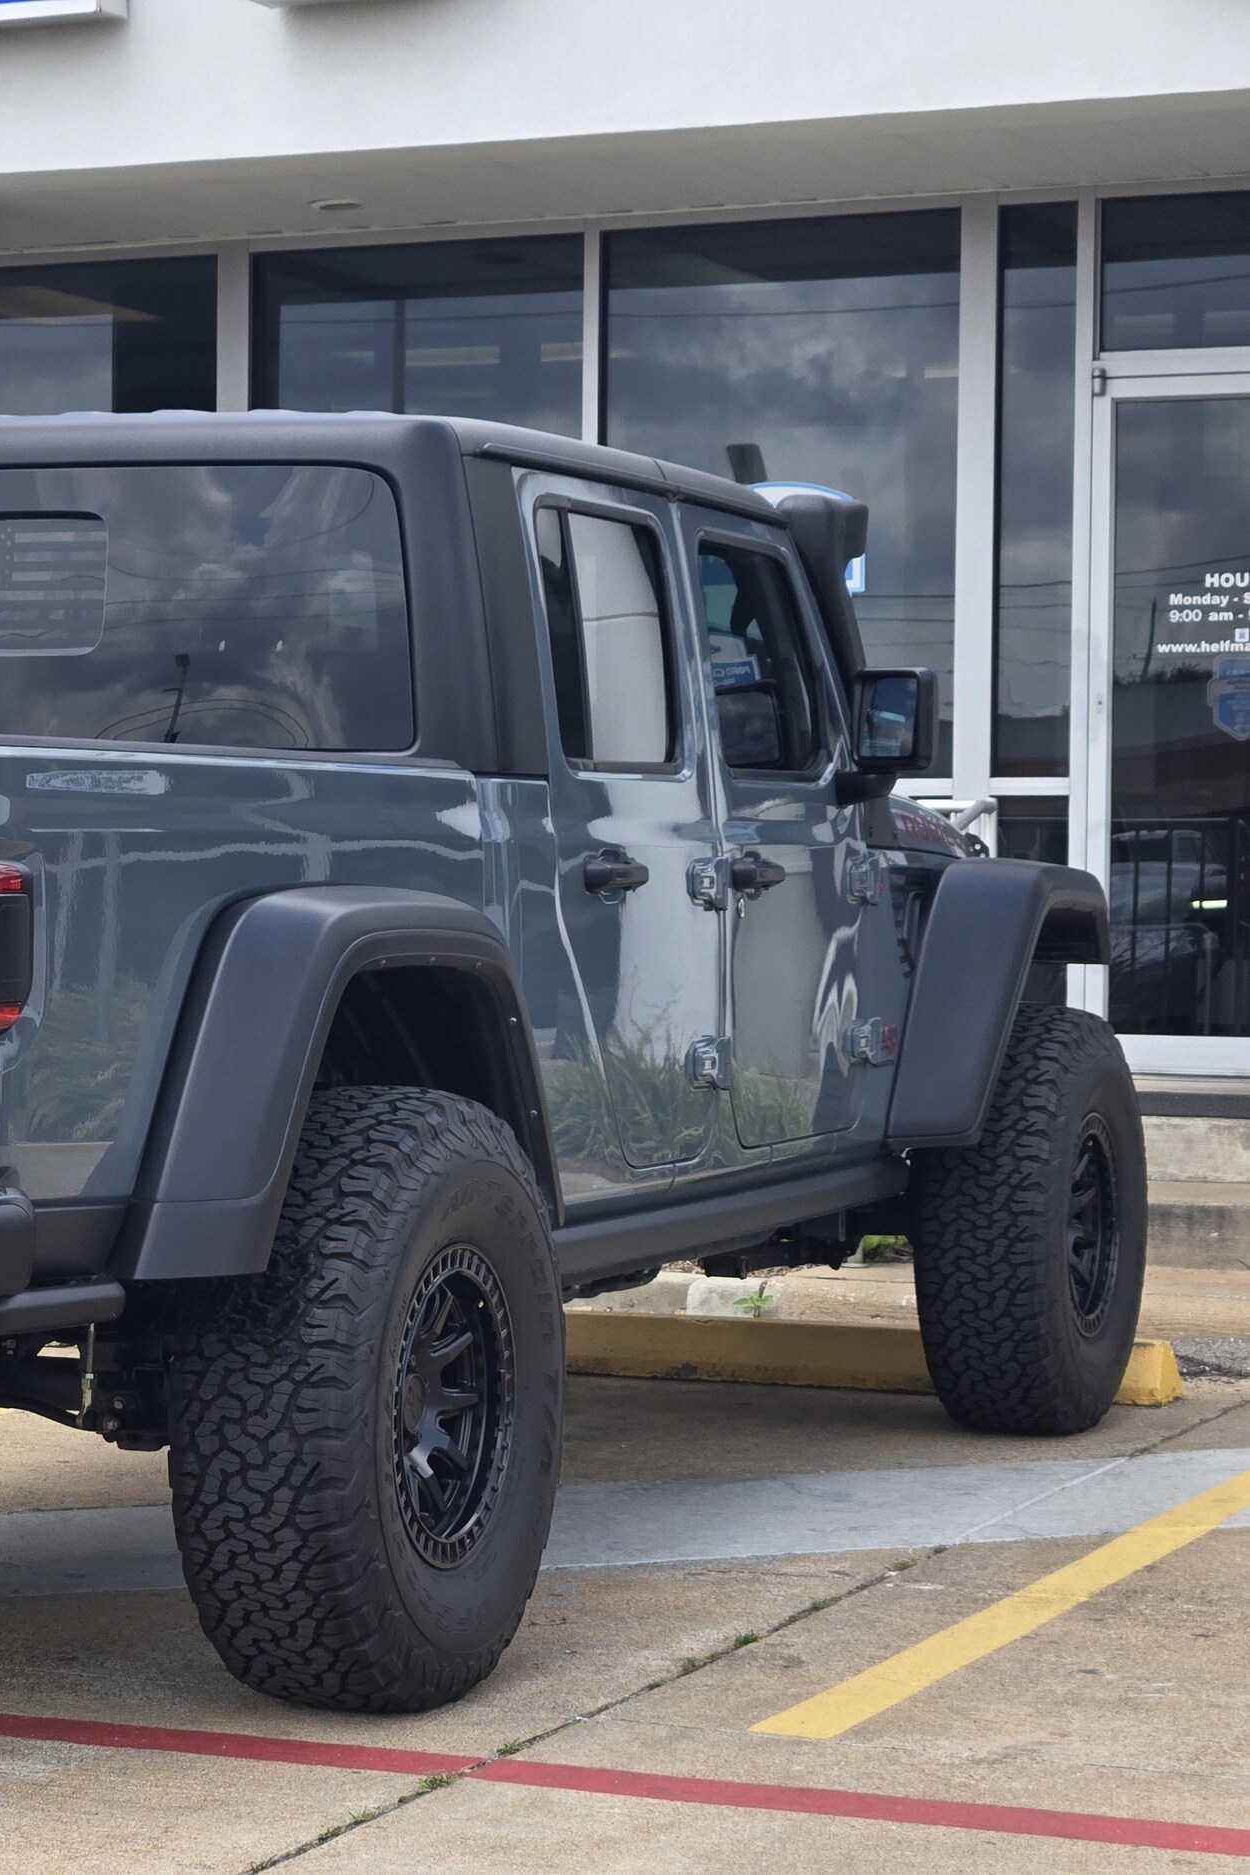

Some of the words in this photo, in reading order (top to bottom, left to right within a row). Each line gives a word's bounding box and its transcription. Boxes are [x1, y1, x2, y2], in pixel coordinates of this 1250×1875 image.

[1169, 593, 1230, 608] Monday
[1169, 609, 1203, 622] 9:00
[1208, 611, 1234, 621] am
